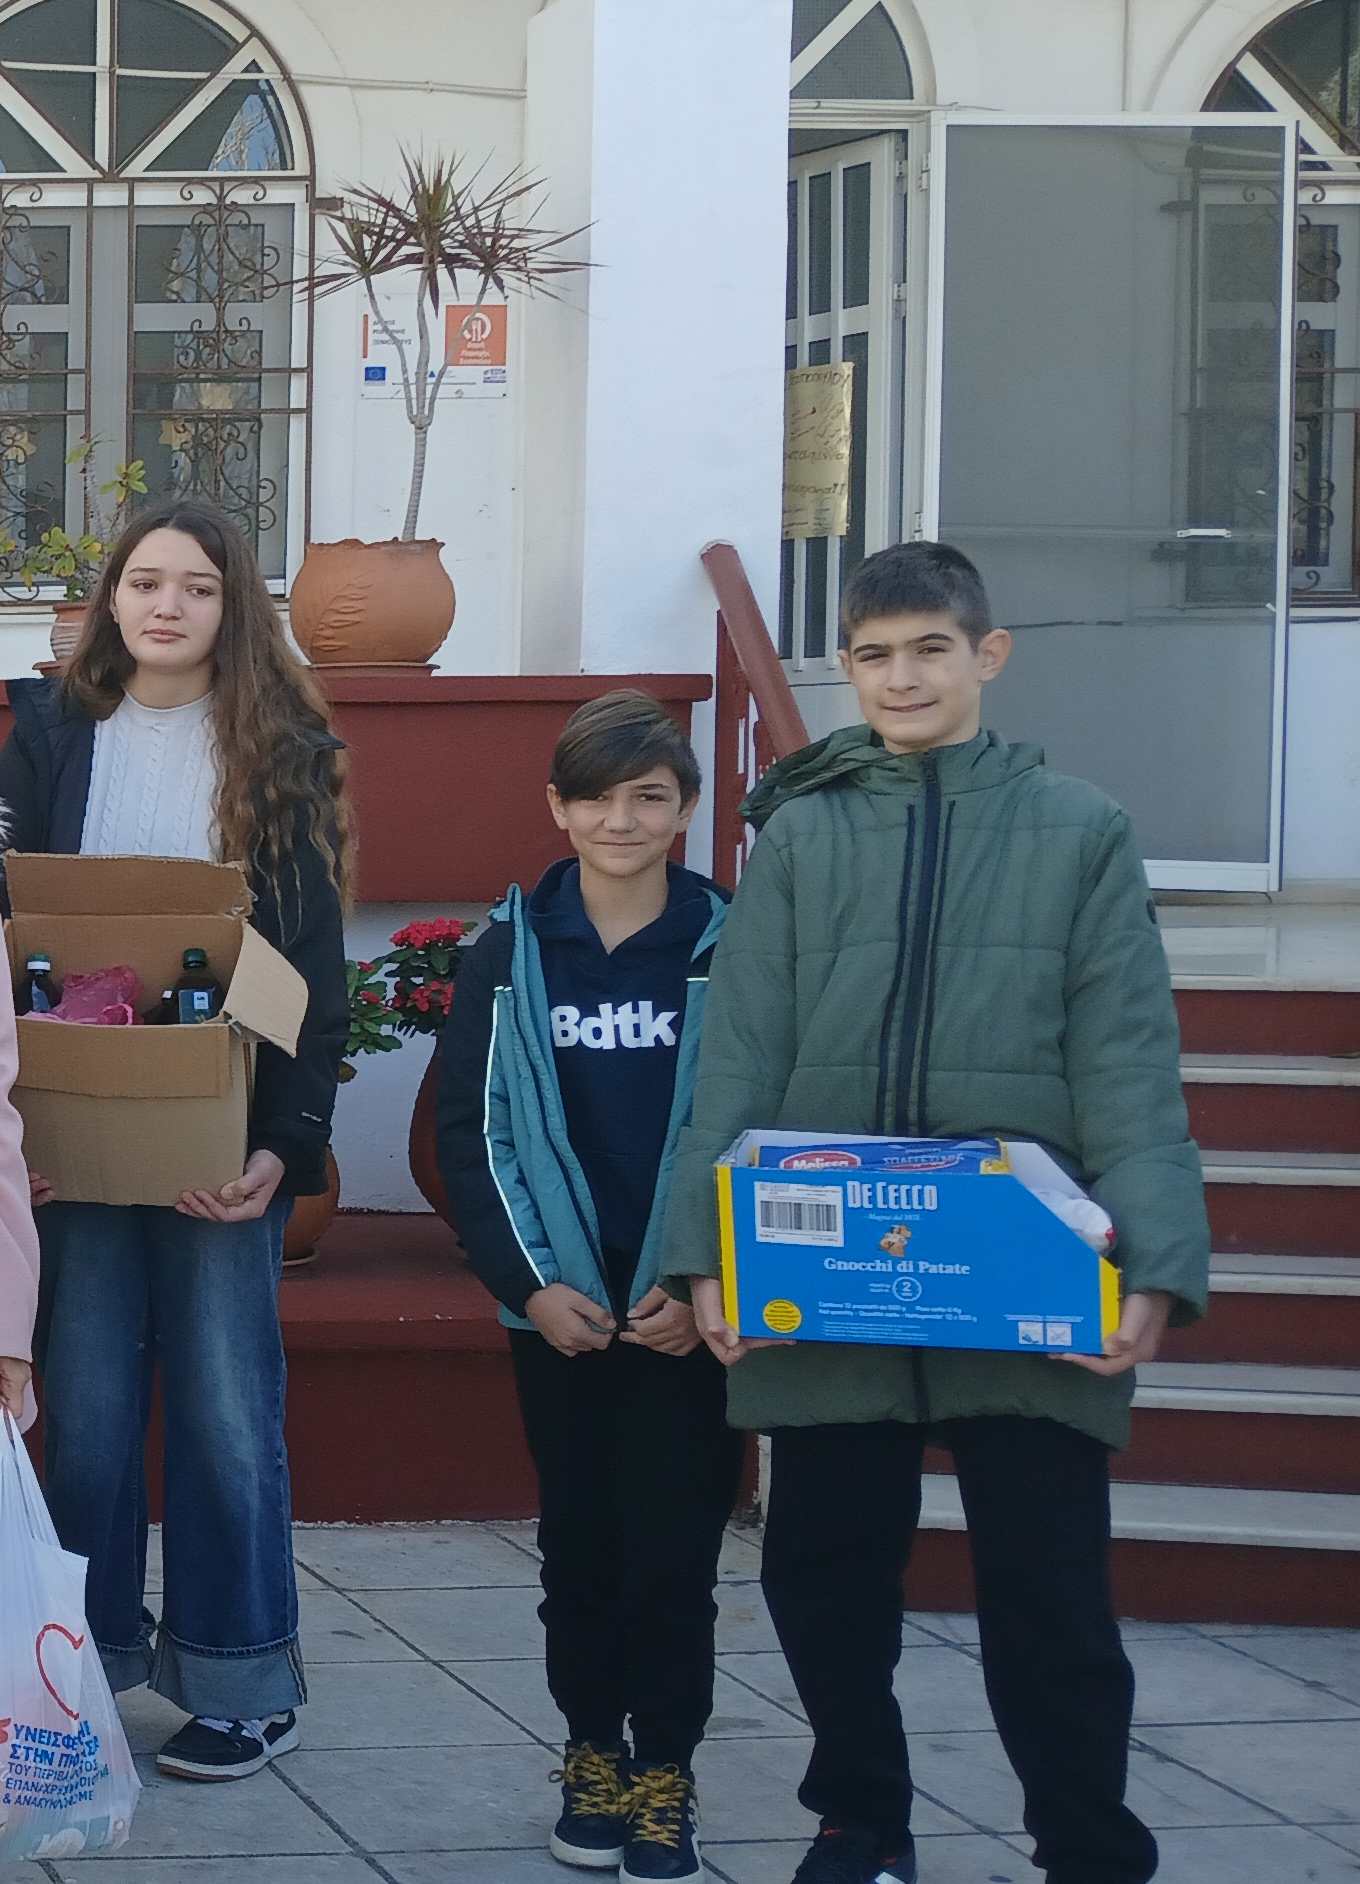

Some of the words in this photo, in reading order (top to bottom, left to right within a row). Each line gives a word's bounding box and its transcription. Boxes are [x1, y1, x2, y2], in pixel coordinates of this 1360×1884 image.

[550, 1000, 679, 1050] Bdtk
[823, 1257, 893, 1273] Gnocchi
[896, 1260, 914, 1273] di
[917, 1261, 971, 1275] Patate
[902, 1281, 912, 1292] 2
[9, 1743, 55, 1766] ΣΤΗΝ
[2, 1792, 12, 1805] &
